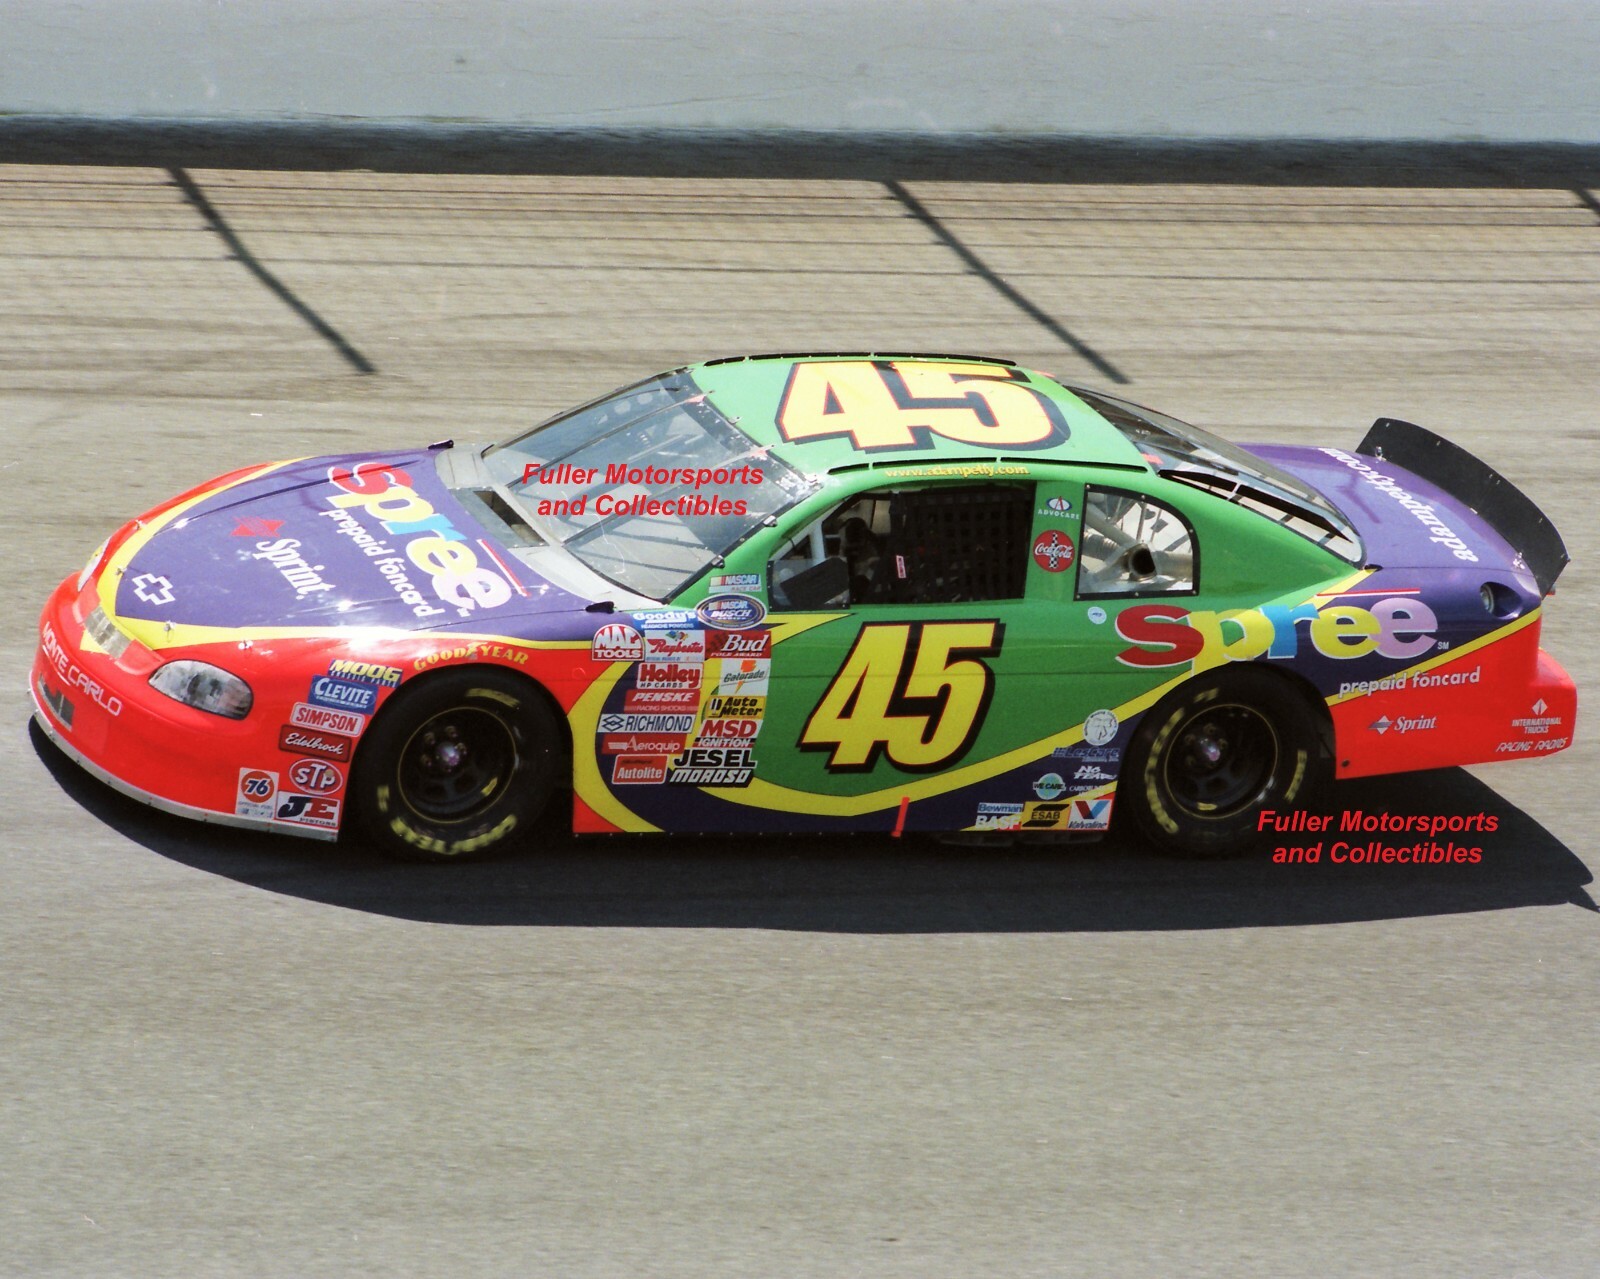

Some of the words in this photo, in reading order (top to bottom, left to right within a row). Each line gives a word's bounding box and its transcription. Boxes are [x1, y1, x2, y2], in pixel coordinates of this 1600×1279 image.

[776, 361, 1066, 452] 45
[1038, 509, 1080, 520] ADVOCARE
[319, 509, 395, 558] prepaid
[253, 538, 336, 601] Sprint
[725, 574, 758, 586] NASCAR
[711, 609, 752, 618] BUSCH
[721, 600, 748, 610] NASCAR
[633, 611, 697, 623] Goody's
[600, 626, 641, 649] MAC
[720, 634, 770, 652] Bud
[595, 650, 641, 659] TOOLS
[329, 659, 403, 682] MOOG
[640, 664, 701, 688] Holley
[723, 670, 765, 683] Gatorade
[67, 665, 123, 717] CARLO
[315, 678, 373, 704] CLEVITE
[1338, 673, 1406, 698] prepaid
[632, 692, 695, 702] PENSKE
[724, 696, 758, 707] Auto
[795, 618, 1006, 774] 45
[296, 707, 359, 732] SIMPSON
[720, 706, 762, 717] Meter
[625, 715, 693, 732] RICHMOND
[700, 719, 757, 737] MSD
[1394, 715, 1437, 733] Sprint
[1512, 717, 1562, 727] INTERNATIONAL
[1524, 726, 1549, 734] TRUCKS
[285, 732, 344, 755] Edelbrock
[626, 735, 681, 753] Aeroquip
[697, 738, 750, 747] IGNITION
[673, 750, 757, 767] JESEL
[295, 763, 335, 789] STP
[617, 767, 663, 779] Autolite
[669, 769, 752, 784] MOROSO
[244, 778, 271, 796] 76
[1034, 782, 1045, 790] WE
[1045, 782, 1064, 790] CARE
[277, 795, 338, 820] JE
[978, 803, 1023, 813] Bowman
[1031, 811, 1061, 820] ESAB
[975, 815, 1021, 829] BASF
[1067, 820, 1108, 830] Valvoline
